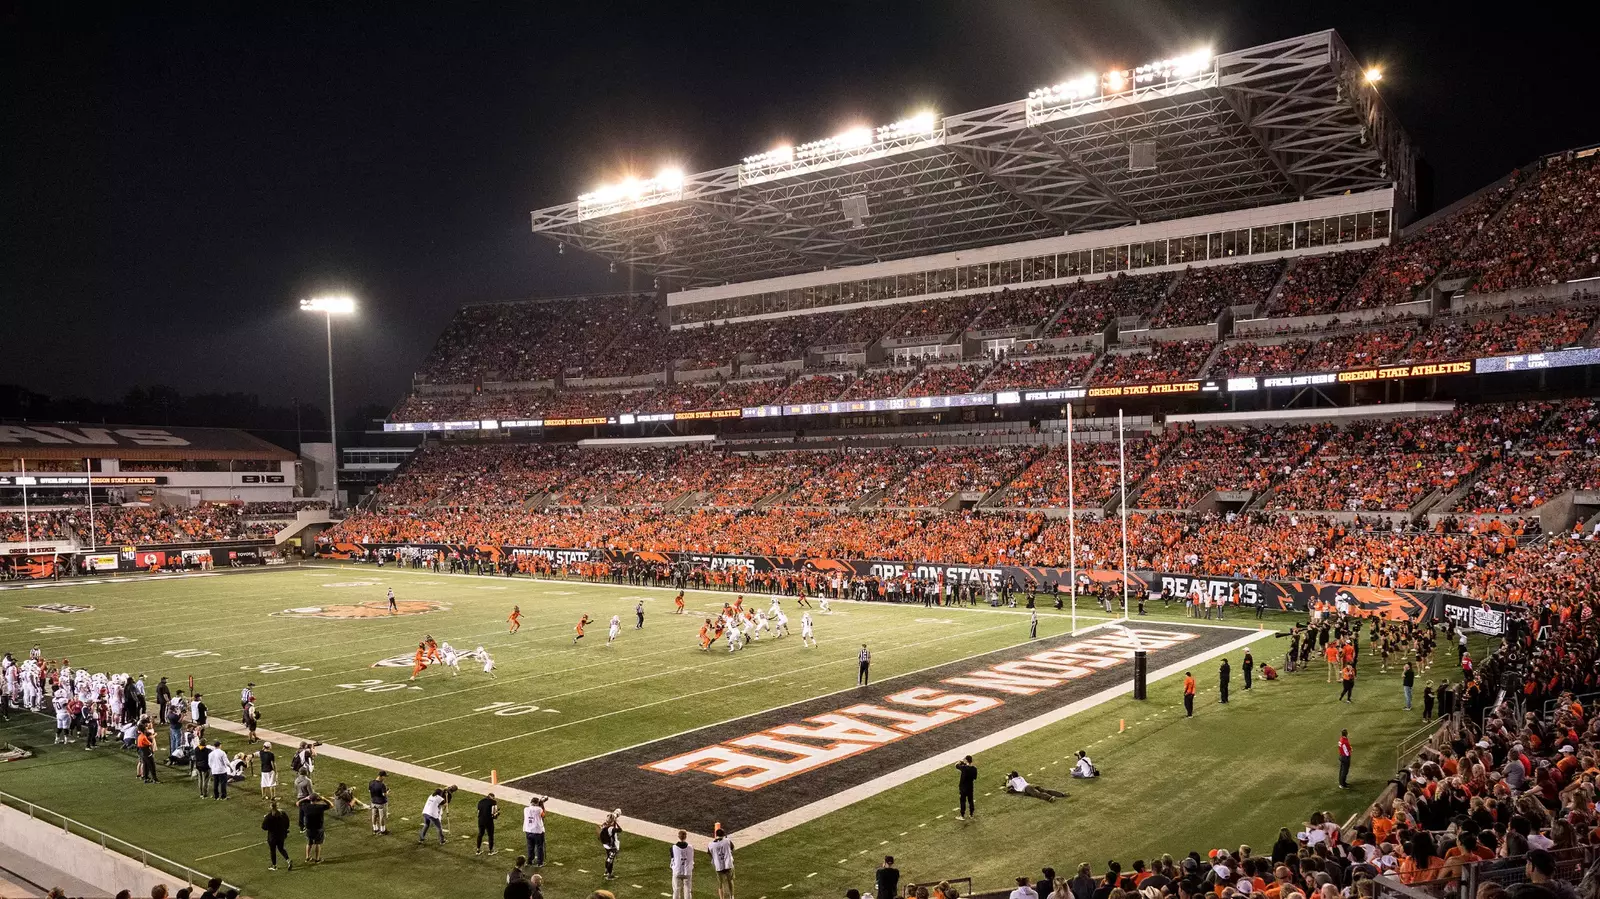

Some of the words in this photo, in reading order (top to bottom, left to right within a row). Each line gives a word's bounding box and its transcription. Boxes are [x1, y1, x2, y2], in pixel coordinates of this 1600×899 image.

[1338, 370, 1377, 382] OREGON
[1378, 368, 1410, 379] STATE
[1411, 361, 1471, 376] ATHLETICS
[1089, 387, 1122, 397] OREGON
[1123, 385, 1149, 395] STATE
[1150, 382, 1199, 394] ATHLETICS
[583, 417, 607, 425] ATHLETICS
[675, 412, 695, 420] OREGON
[696, 411, 711, 419] STATE
[712, 409, 740, 418] ATHLETICS
[122, 551, 134, 560] 40
[556, 551, 589, 565] STATE
[870, 564, 941, 582] OREON
[946, 568, 1002, 587] STATE
[335, 679, 408, 692] 20
[472, 701, 540, 716] 10
[636, 686, 1005, 792] STATE
